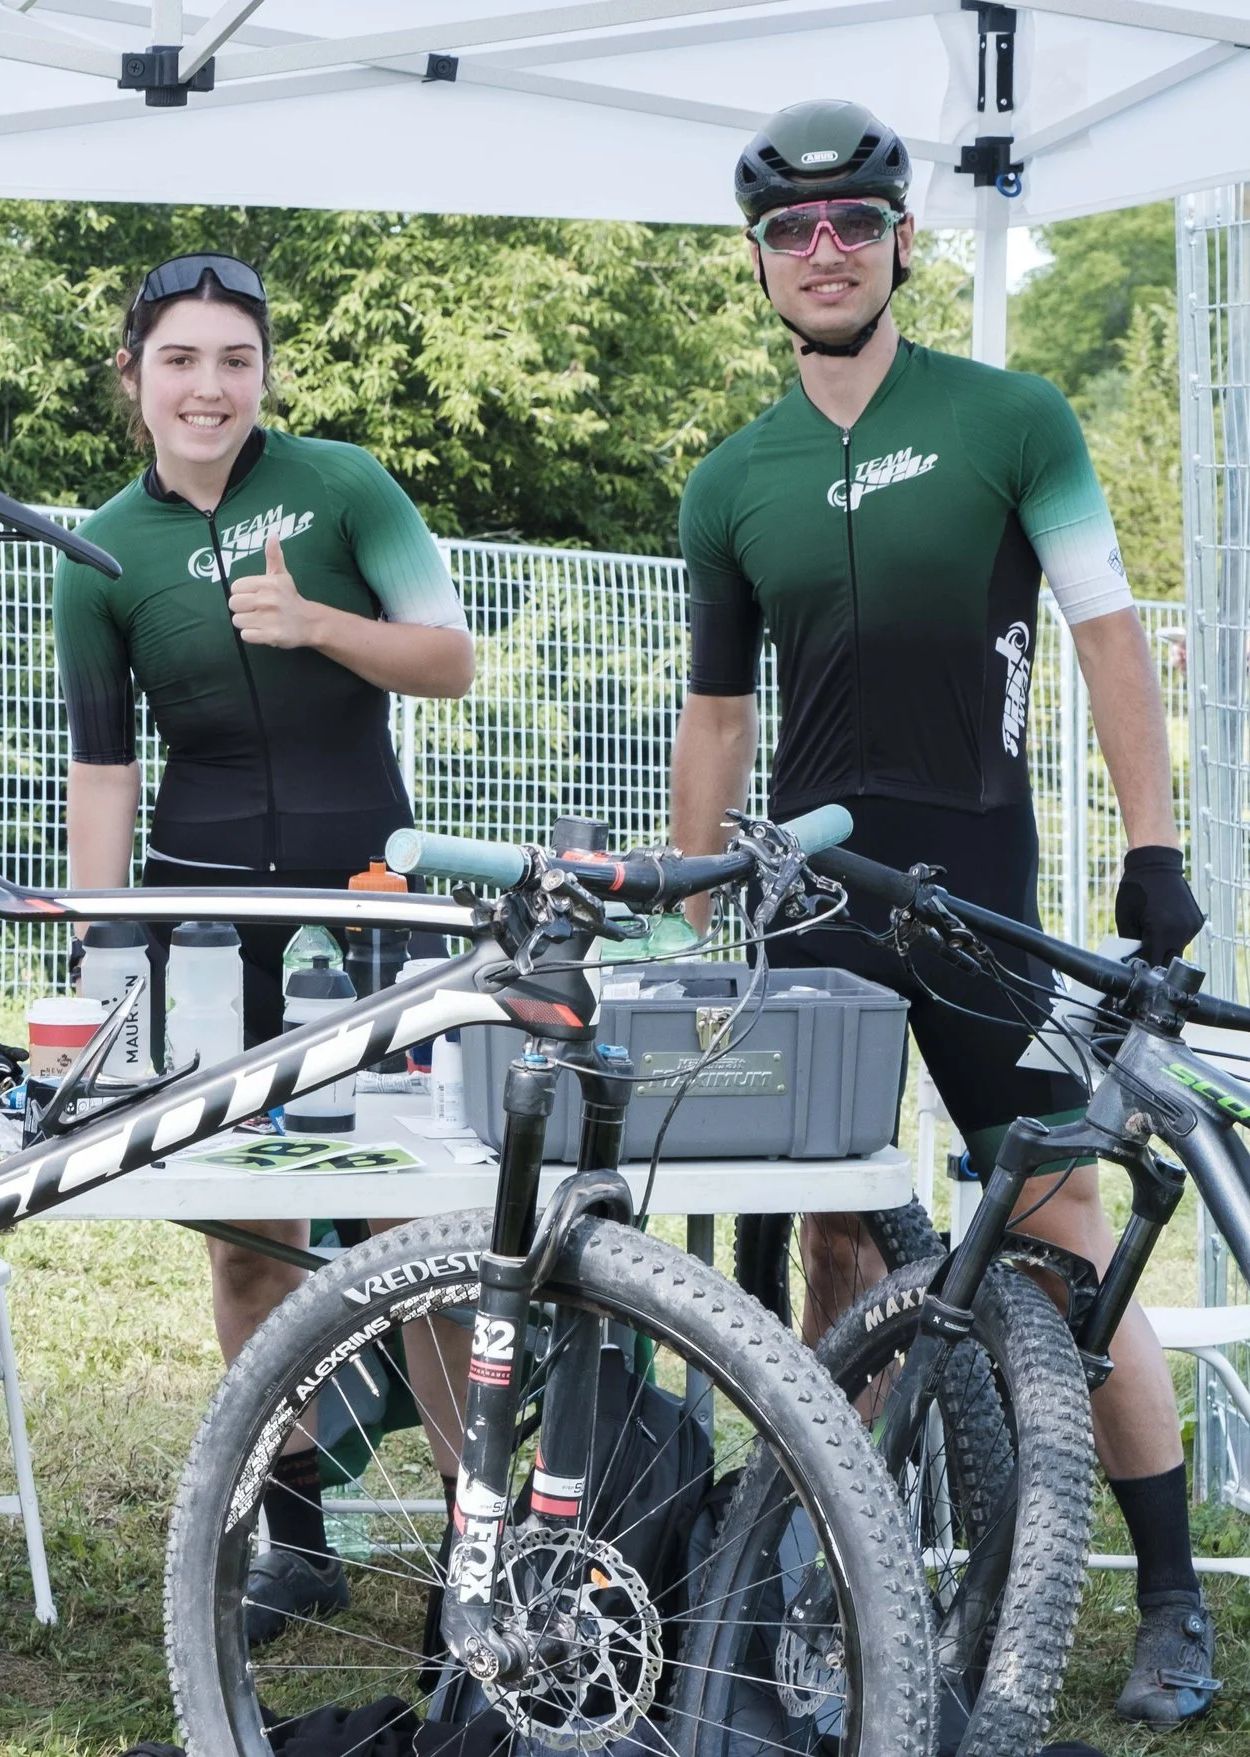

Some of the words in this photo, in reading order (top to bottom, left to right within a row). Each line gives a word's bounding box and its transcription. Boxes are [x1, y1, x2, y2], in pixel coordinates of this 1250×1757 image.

[855, 446, 912, 480] TEAM
[221, 504, 283, 543] TEAM
[125, 975, 139, 1063] MAURN
[1159, 1063, 1250, 1119] SCO
[343, 1250, 482, 1305] VREDEST
[472, 1314, 515, 1360] 32
[865, 1286, 927, 1333] MAXX
[295, 1315, 391, 1402] ALEXRIMS
[456, 1518, 499, 1604] FOX
